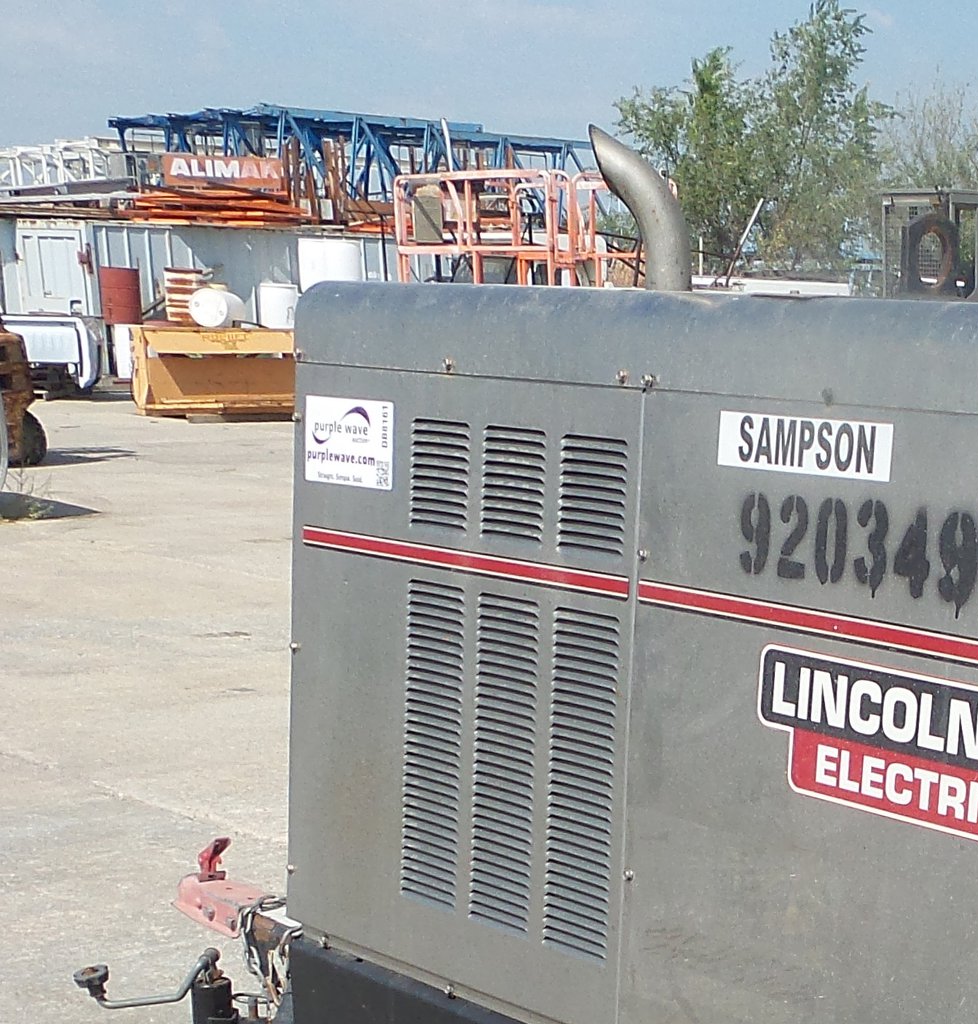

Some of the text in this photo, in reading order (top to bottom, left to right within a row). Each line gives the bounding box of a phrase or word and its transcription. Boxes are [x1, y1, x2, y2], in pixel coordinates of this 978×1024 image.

[170, 157, 280, 180] ALIMAK
[314, 421, 368, 437] purple wave
[738, 415, 876, 474] SAMPSON
[307, 448, 376, 466] purplewave.com
